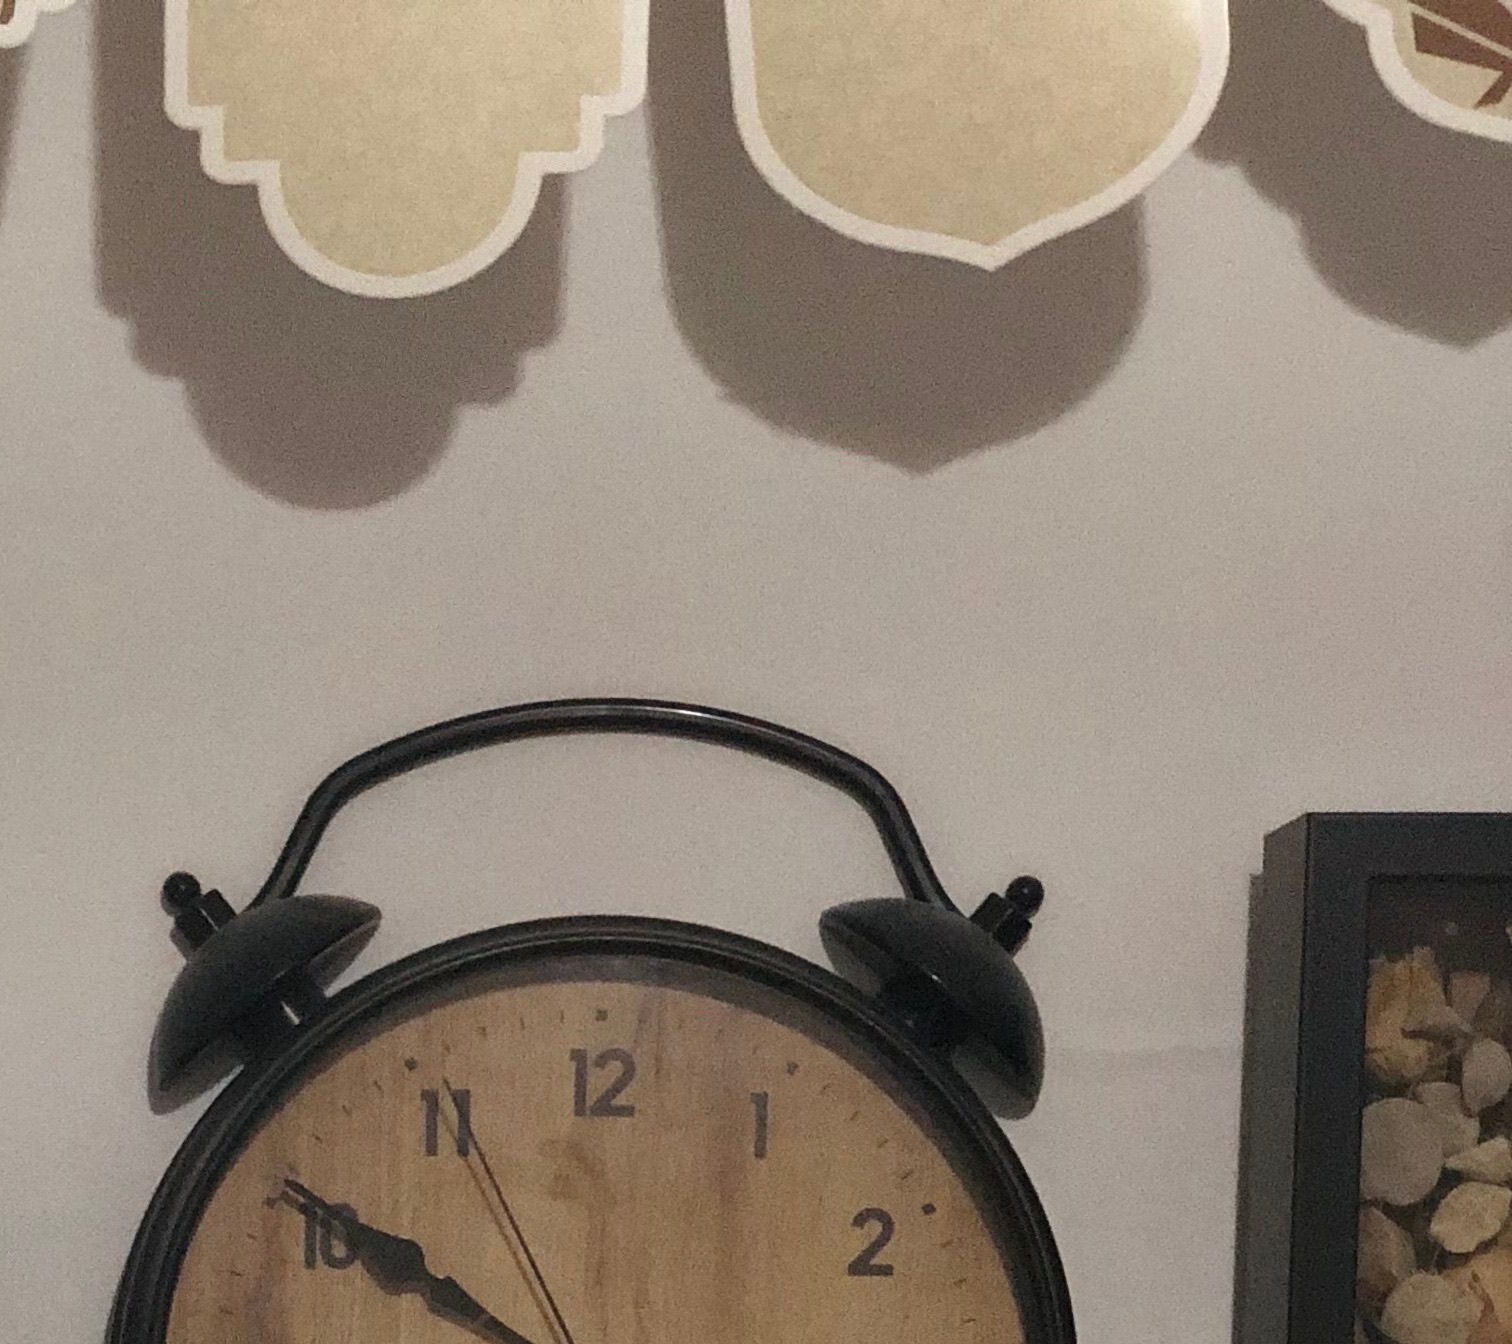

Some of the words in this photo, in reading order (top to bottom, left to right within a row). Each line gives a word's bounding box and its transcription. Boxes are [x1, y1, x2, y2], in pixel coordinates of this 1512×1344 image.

[569, 1048, 636, 1118] 12
[420, 1088, 472, 1158] 11
[750, 1091, 769, 1159] 1
[847, 1207, 895, 1277] 2
